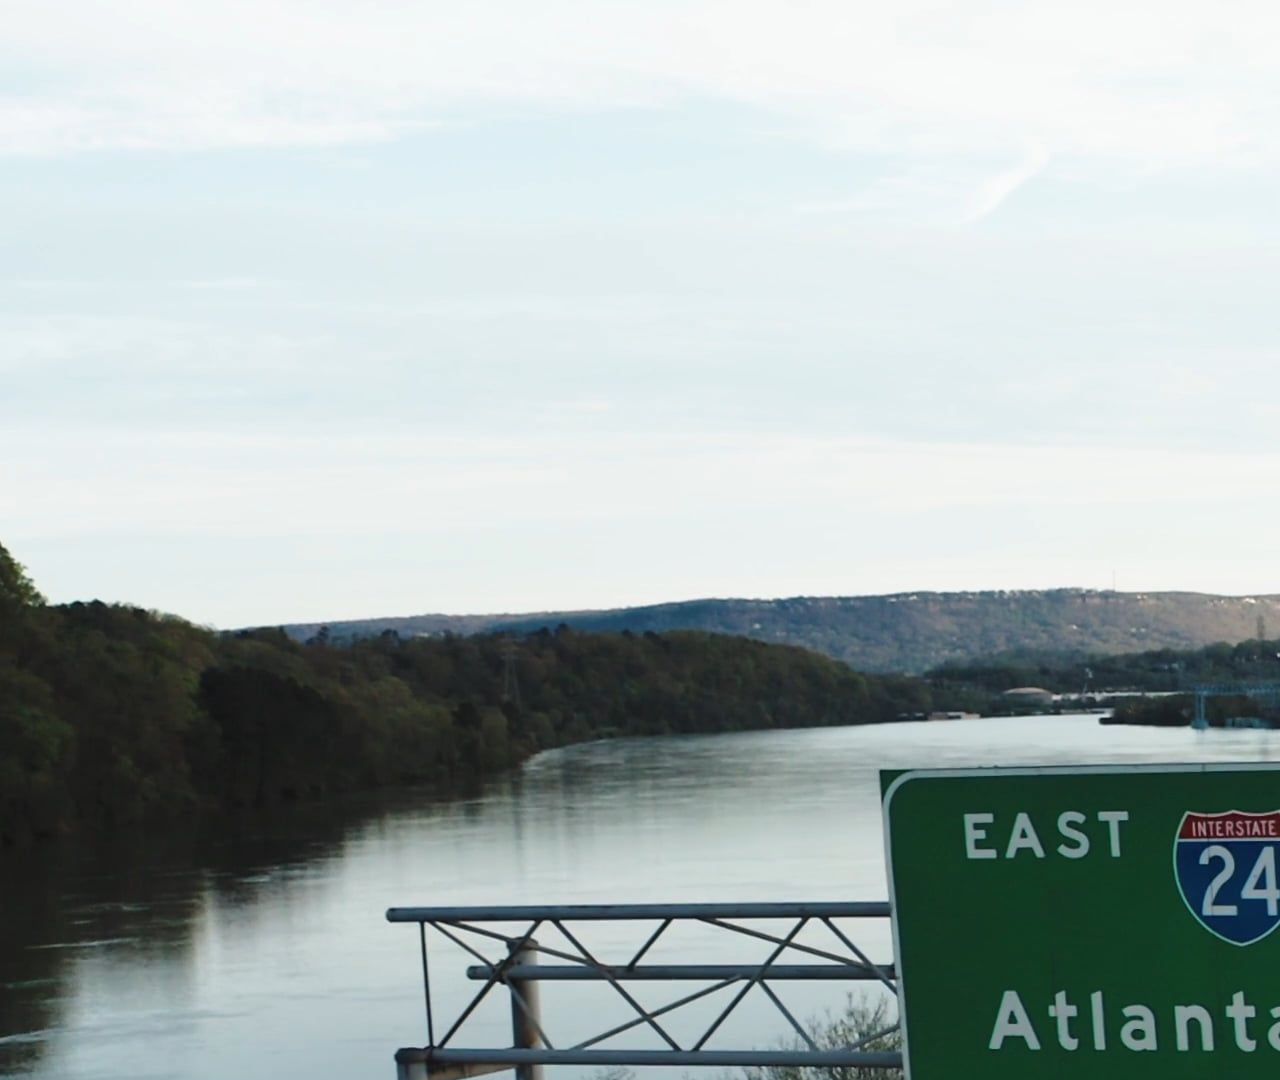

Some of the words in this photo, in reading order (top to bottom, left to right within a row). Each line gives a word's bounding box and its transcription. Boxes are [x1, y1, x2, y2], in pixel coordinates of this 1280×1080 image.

[963, 811, 1129, 860] EAST
[1192, 820, 1277, 837] INTERSTATE
[1199, 845, 1280, 916] 24
